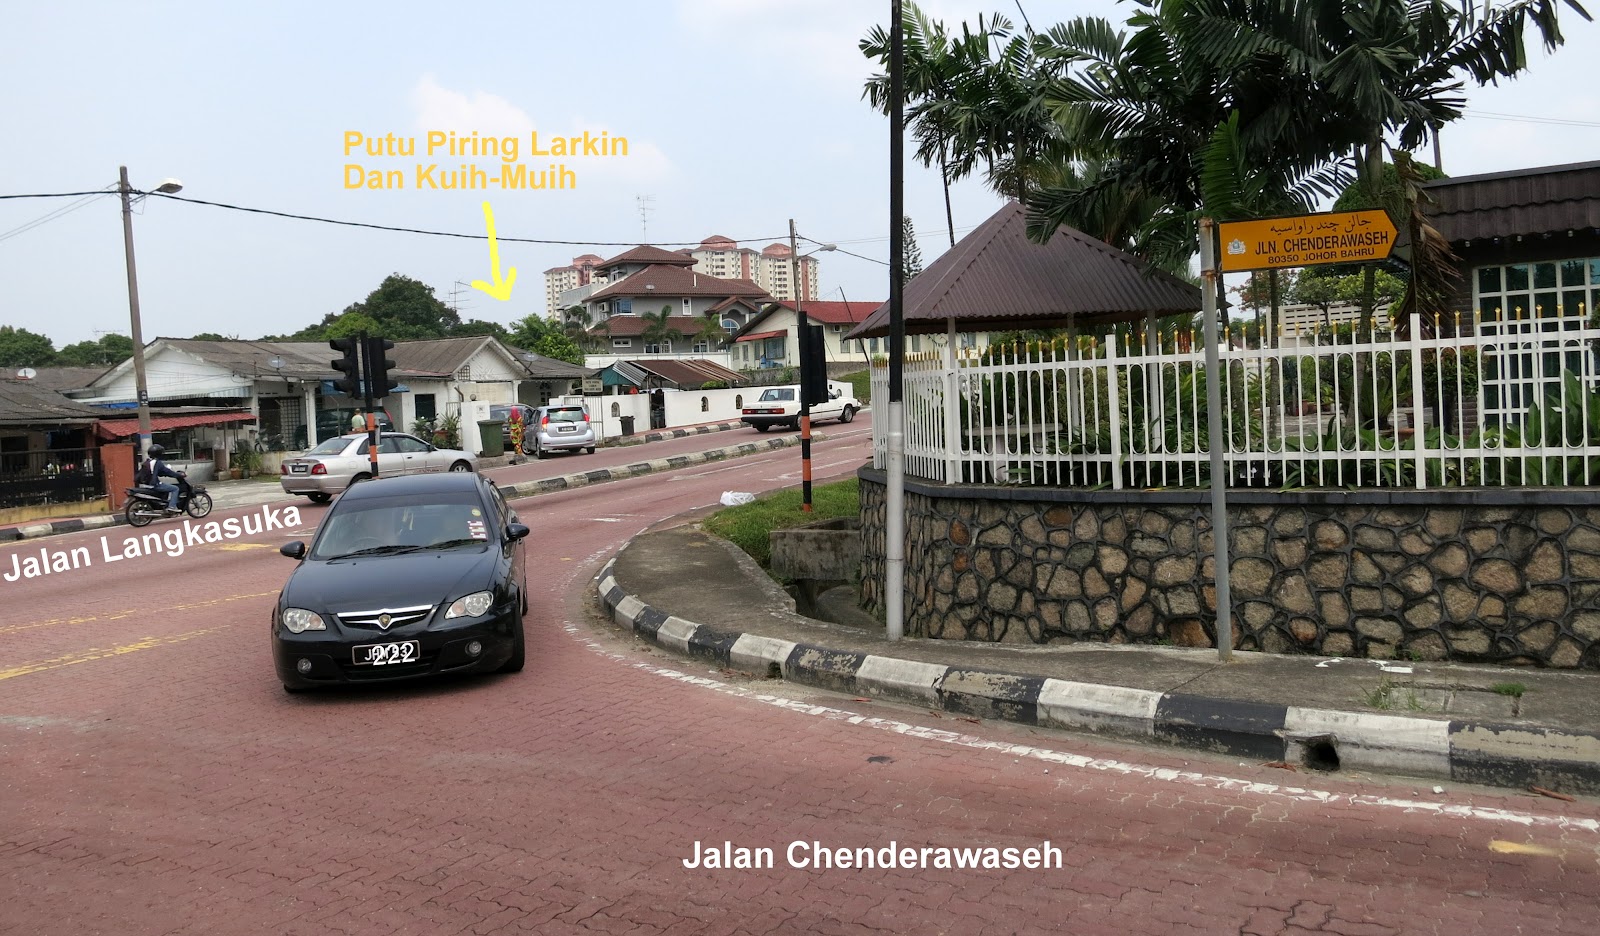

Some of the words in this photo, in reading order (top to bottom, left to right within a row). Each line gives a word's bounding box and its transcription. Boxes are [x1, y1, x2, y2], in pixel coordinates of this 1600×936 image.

[1255, 240, 1280, 256] JLN.
[1283, 231, 1389, 254] CHENDERAWASEH
[1268, 254, 1299, 264] 80350
[1302, 250, 1337, 262] JOHOR
[1340, 247, 1375, 258] BAHRU
